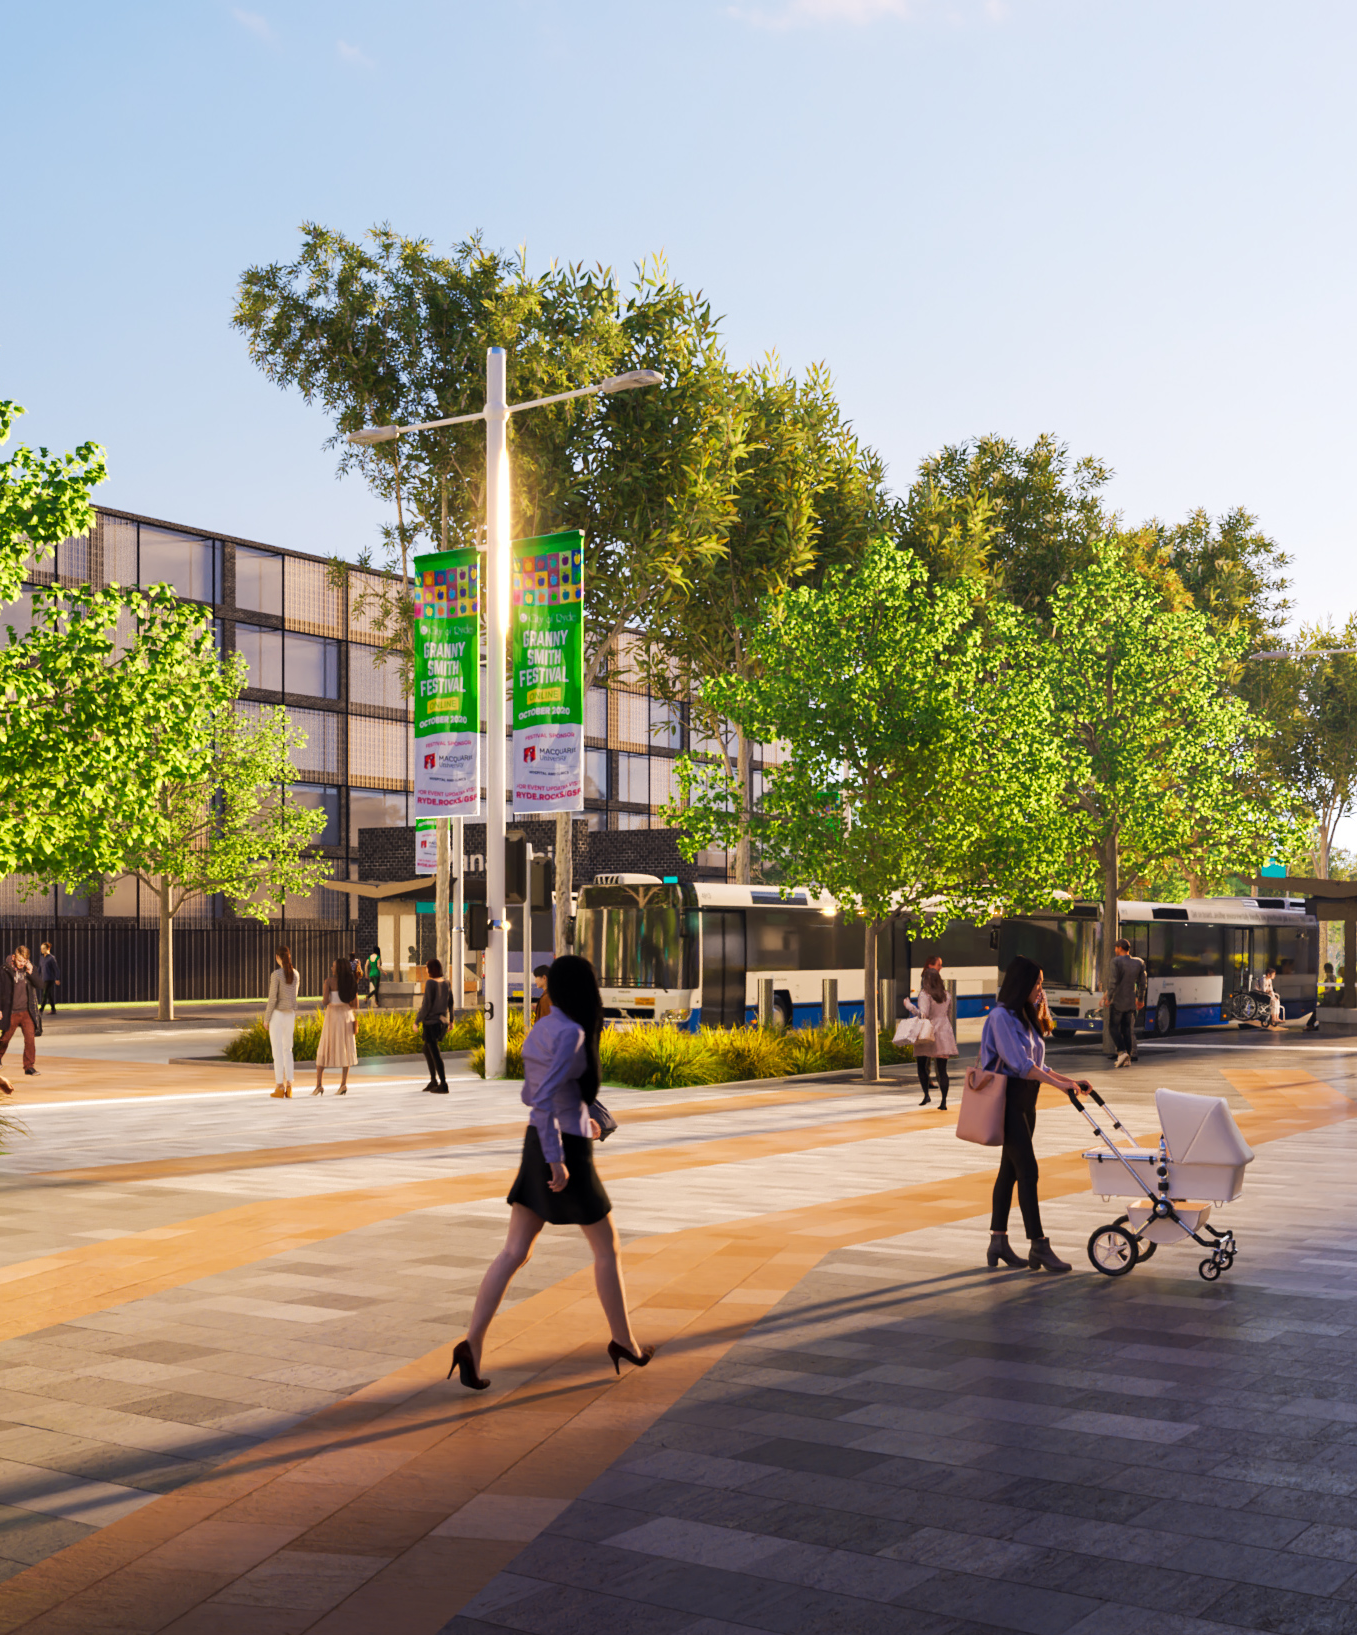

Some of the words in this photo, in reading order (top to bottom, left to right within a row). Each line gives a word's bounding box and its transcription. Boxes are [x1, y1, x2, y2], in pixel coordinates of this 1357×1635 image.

[523, 629, 569, 648] GRANNY
[423, 641, 466, 659] GRANNY
[527, 648, 562, 666] SMITH
[427, 660, 459, 676] SMITH
[519, 665, 569, 688] FESTIVAL
[420, 677, 466, 697] FESTIVAL
[529, 689, 558, 702] ONLINE
[429, 699, 457, 711] ONLINE
[518, 706, 551, 720] OCTOBER
[552, 706, 571, 716] 2020
[419, 715, 450, 728] OCTOBER
[450, 715, 468, 724] 2020
